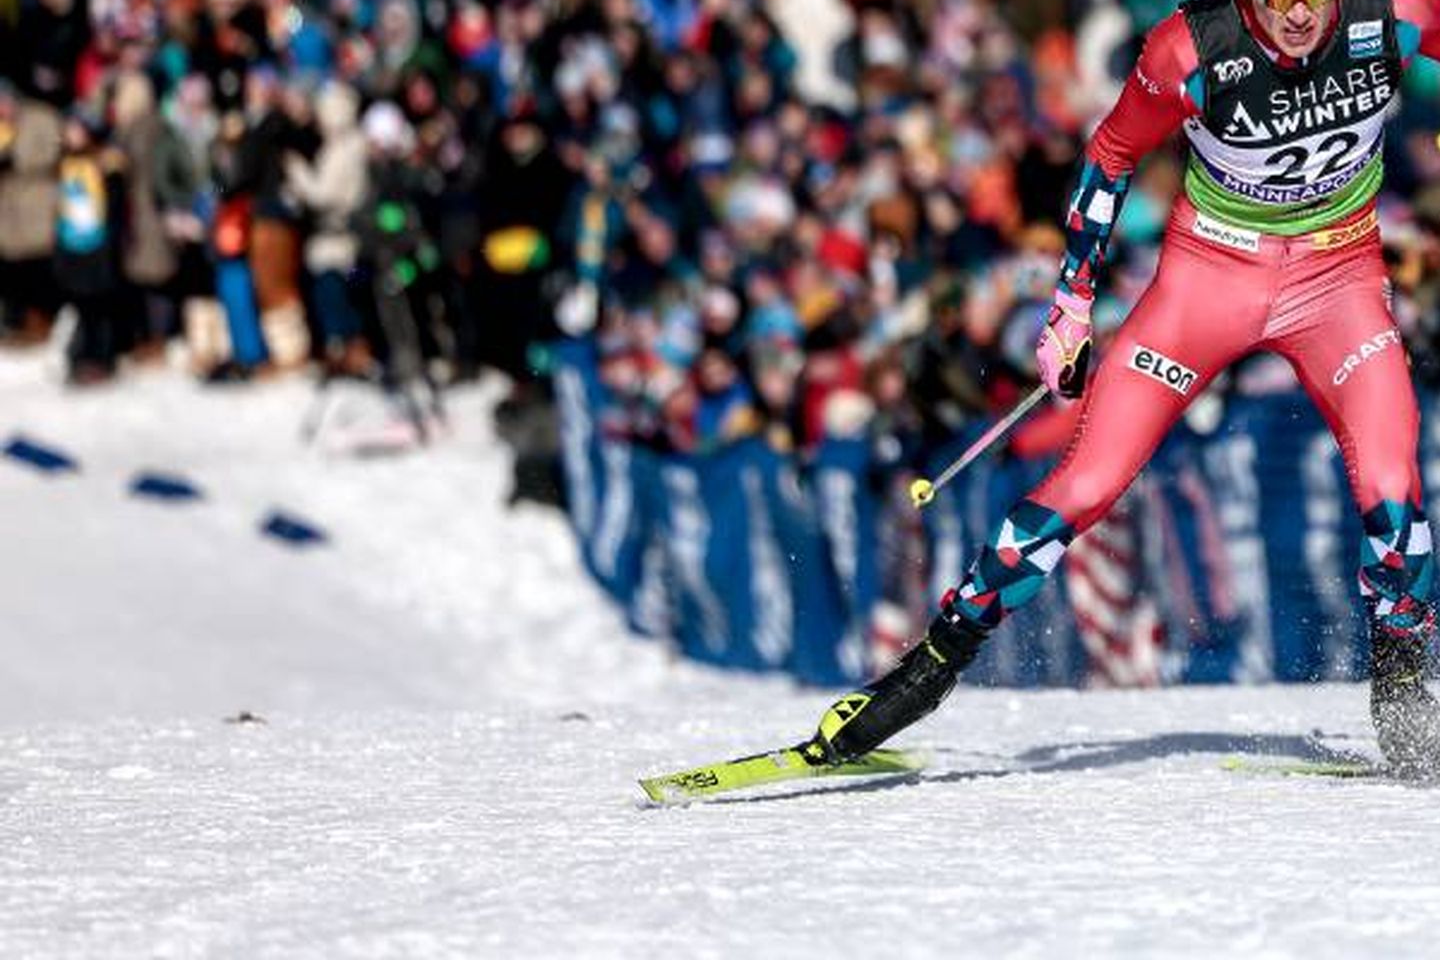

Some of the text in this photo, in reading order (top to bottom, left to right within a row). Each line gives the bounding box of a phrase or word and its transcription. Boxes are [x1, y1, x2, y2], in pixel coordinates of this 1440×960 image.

[1270, 60, 1388, 114] SHARE
[1271, 84, 1391, 136] WINTER
[1263, 131, 1360, 185] 22
